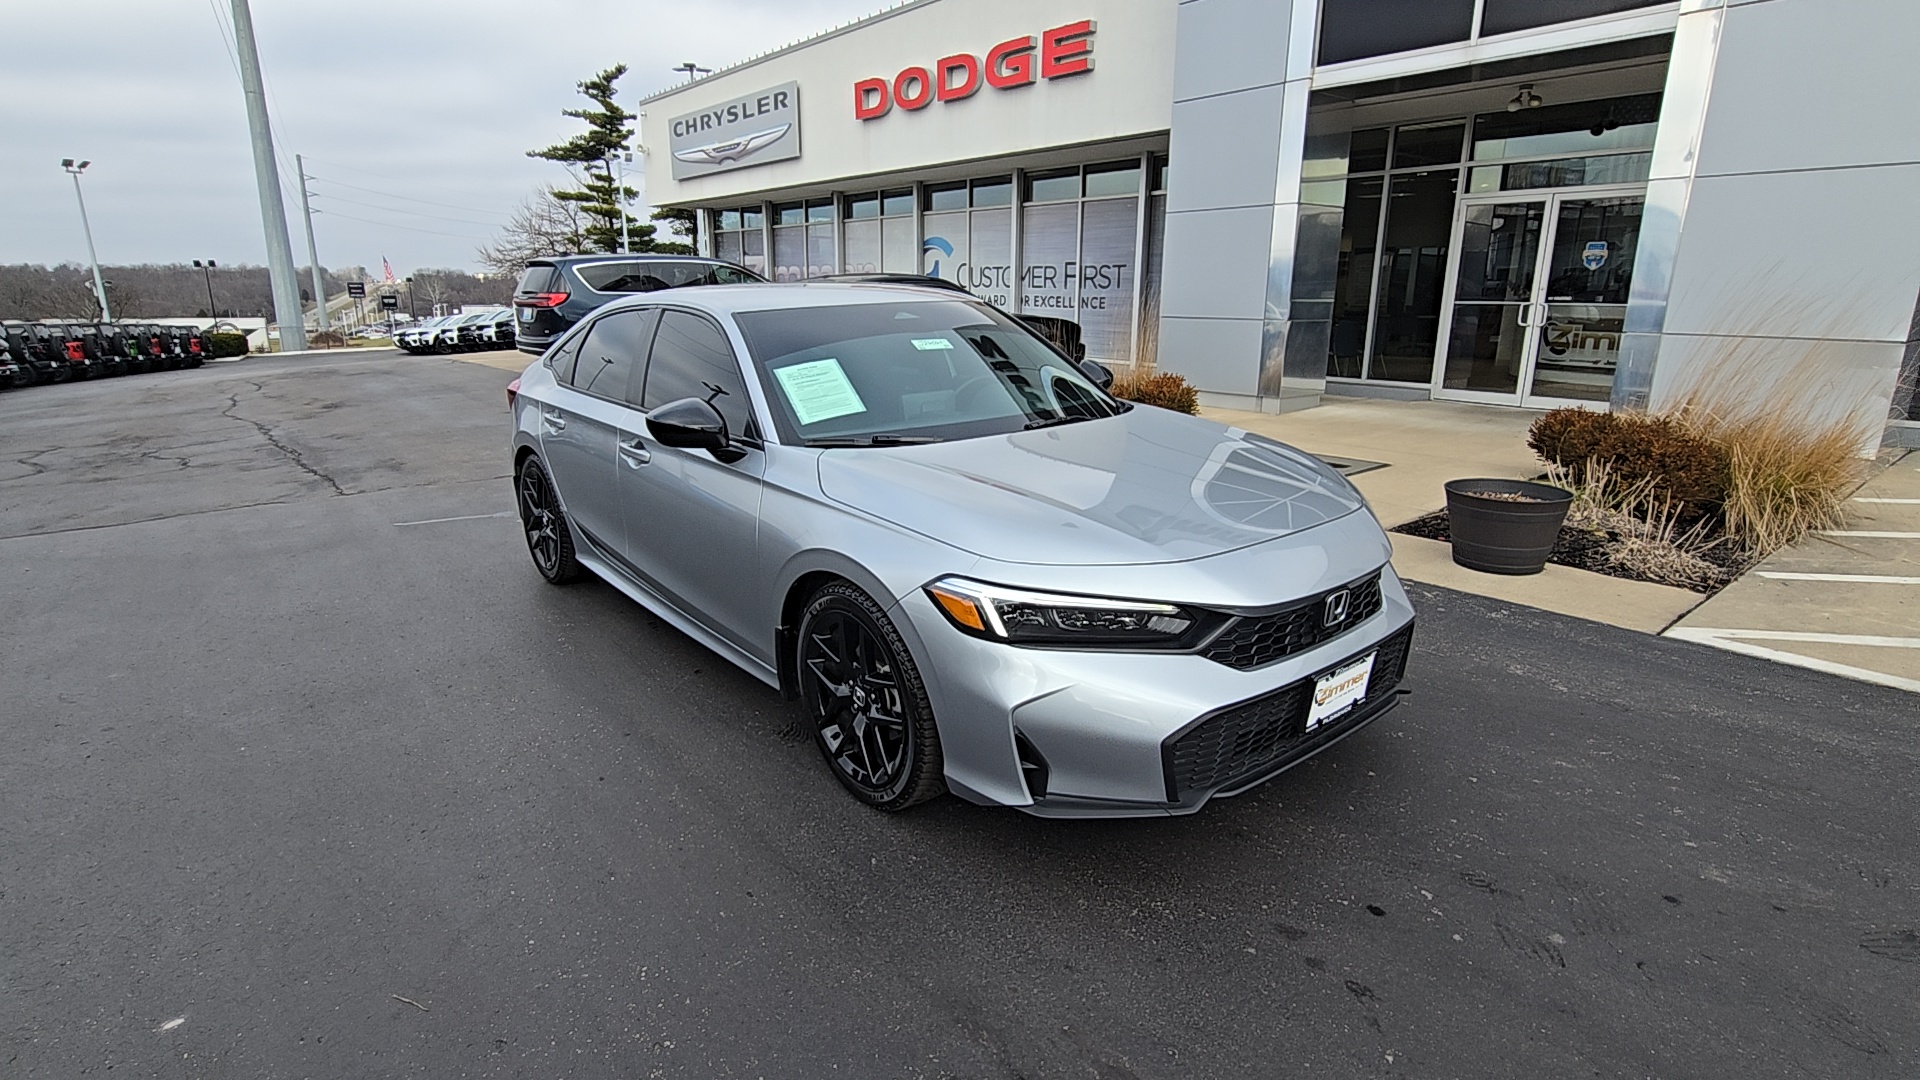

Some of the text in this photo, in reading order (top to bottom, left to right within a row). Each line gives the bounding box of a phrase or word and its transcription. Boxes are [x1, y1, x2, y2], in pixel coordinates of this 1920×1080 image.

[853, 19, 1097, 121] DODGE
[673, 91, 789, 138] CHRYSLER
[976, 294, 1007, 306] WARD
[1033, 295, 1106, 310] EXCELLNCE
[1548, 324, 1620, 352] Zim
